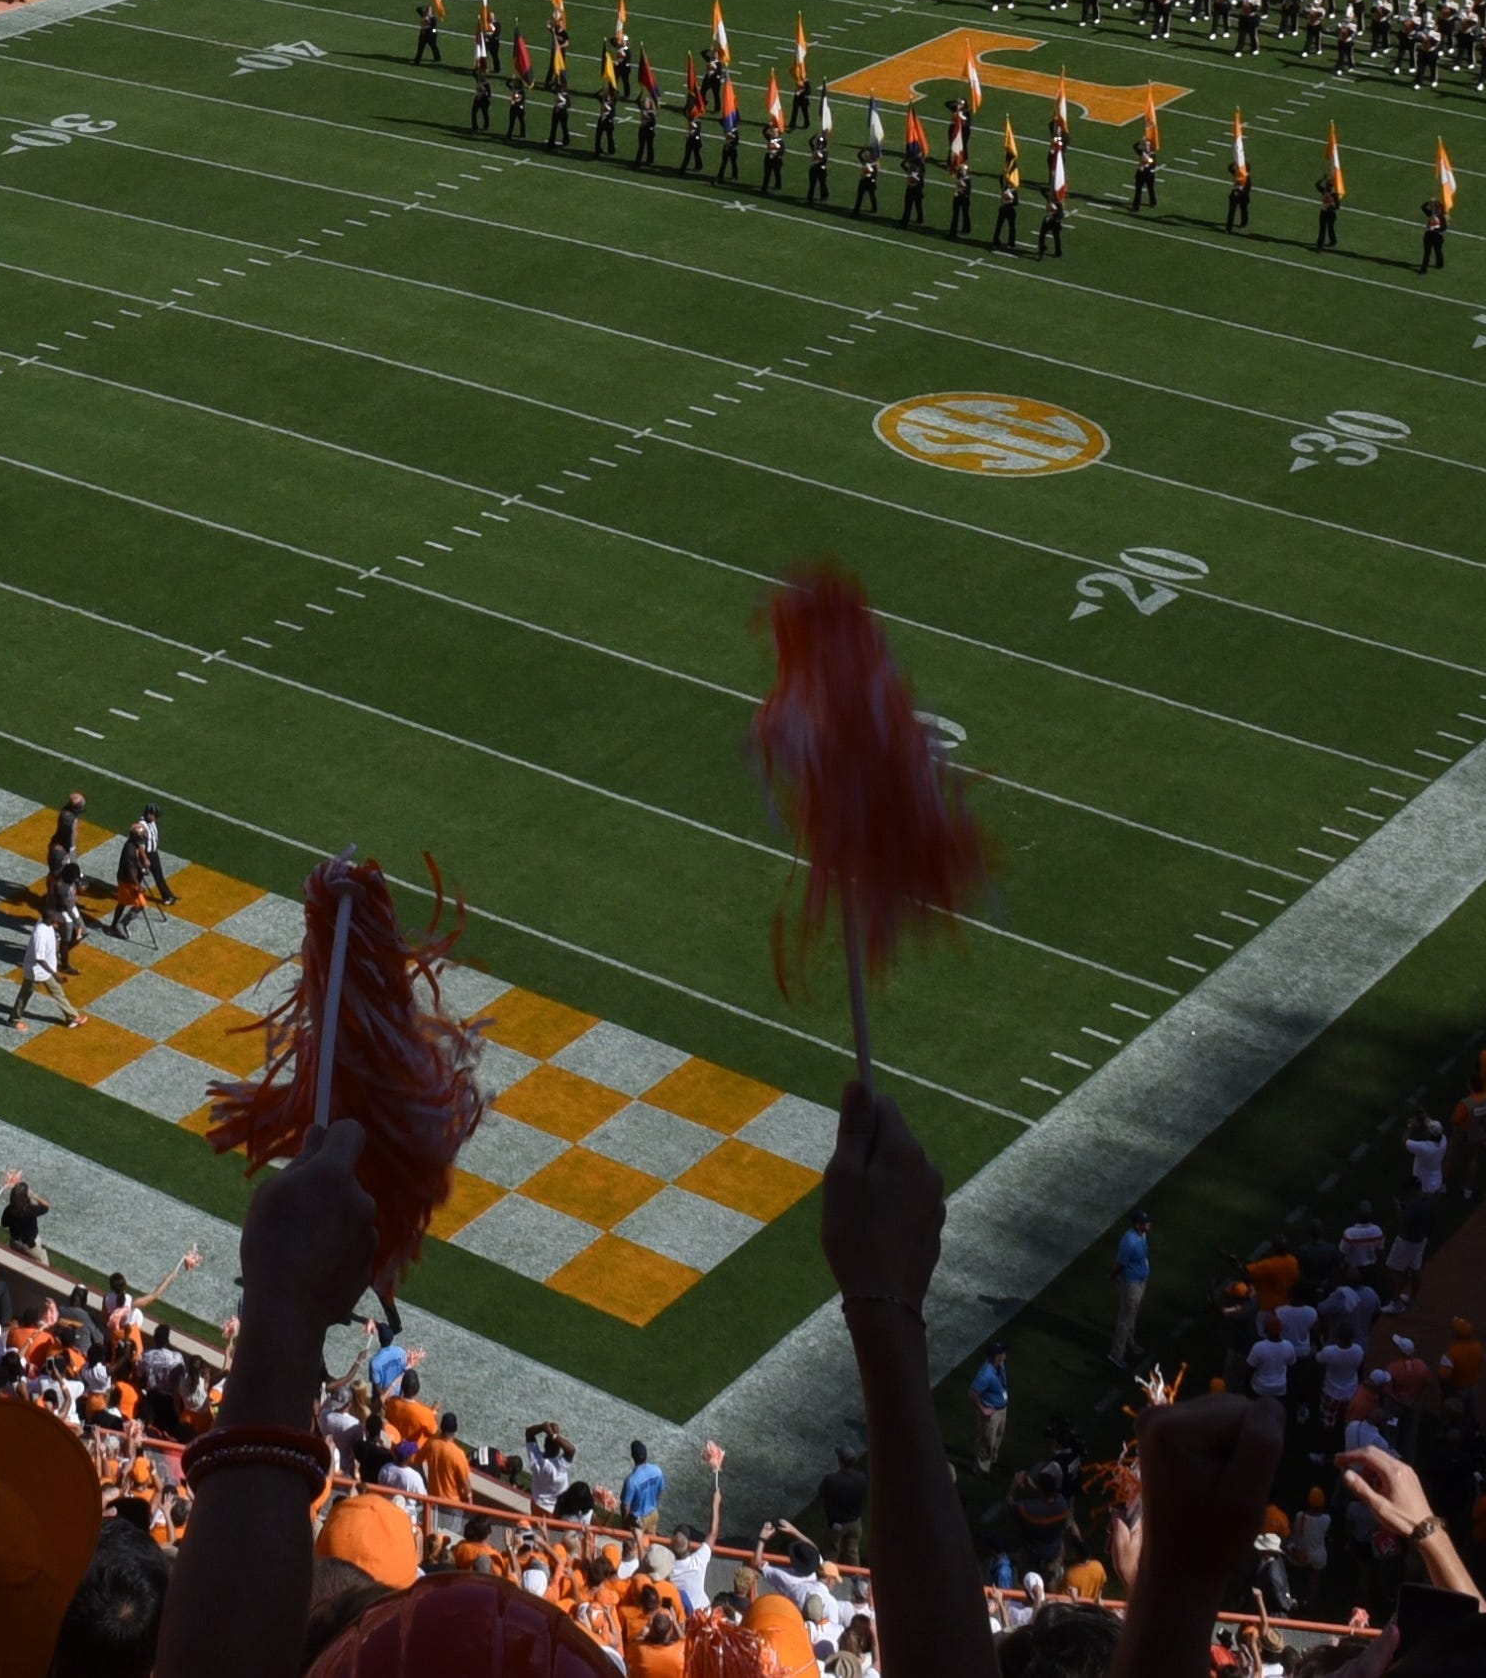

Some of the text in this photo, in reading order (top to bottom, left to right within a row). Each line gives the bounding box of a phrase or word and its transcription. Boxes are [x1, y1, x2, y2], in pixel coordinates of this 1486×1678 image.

[11, 113, 117, 147] 30
[896, 398, 1094, 471] SEC
[1290, 410, 1412, 467] 30
[1076, 546, 1210, 616] 20
